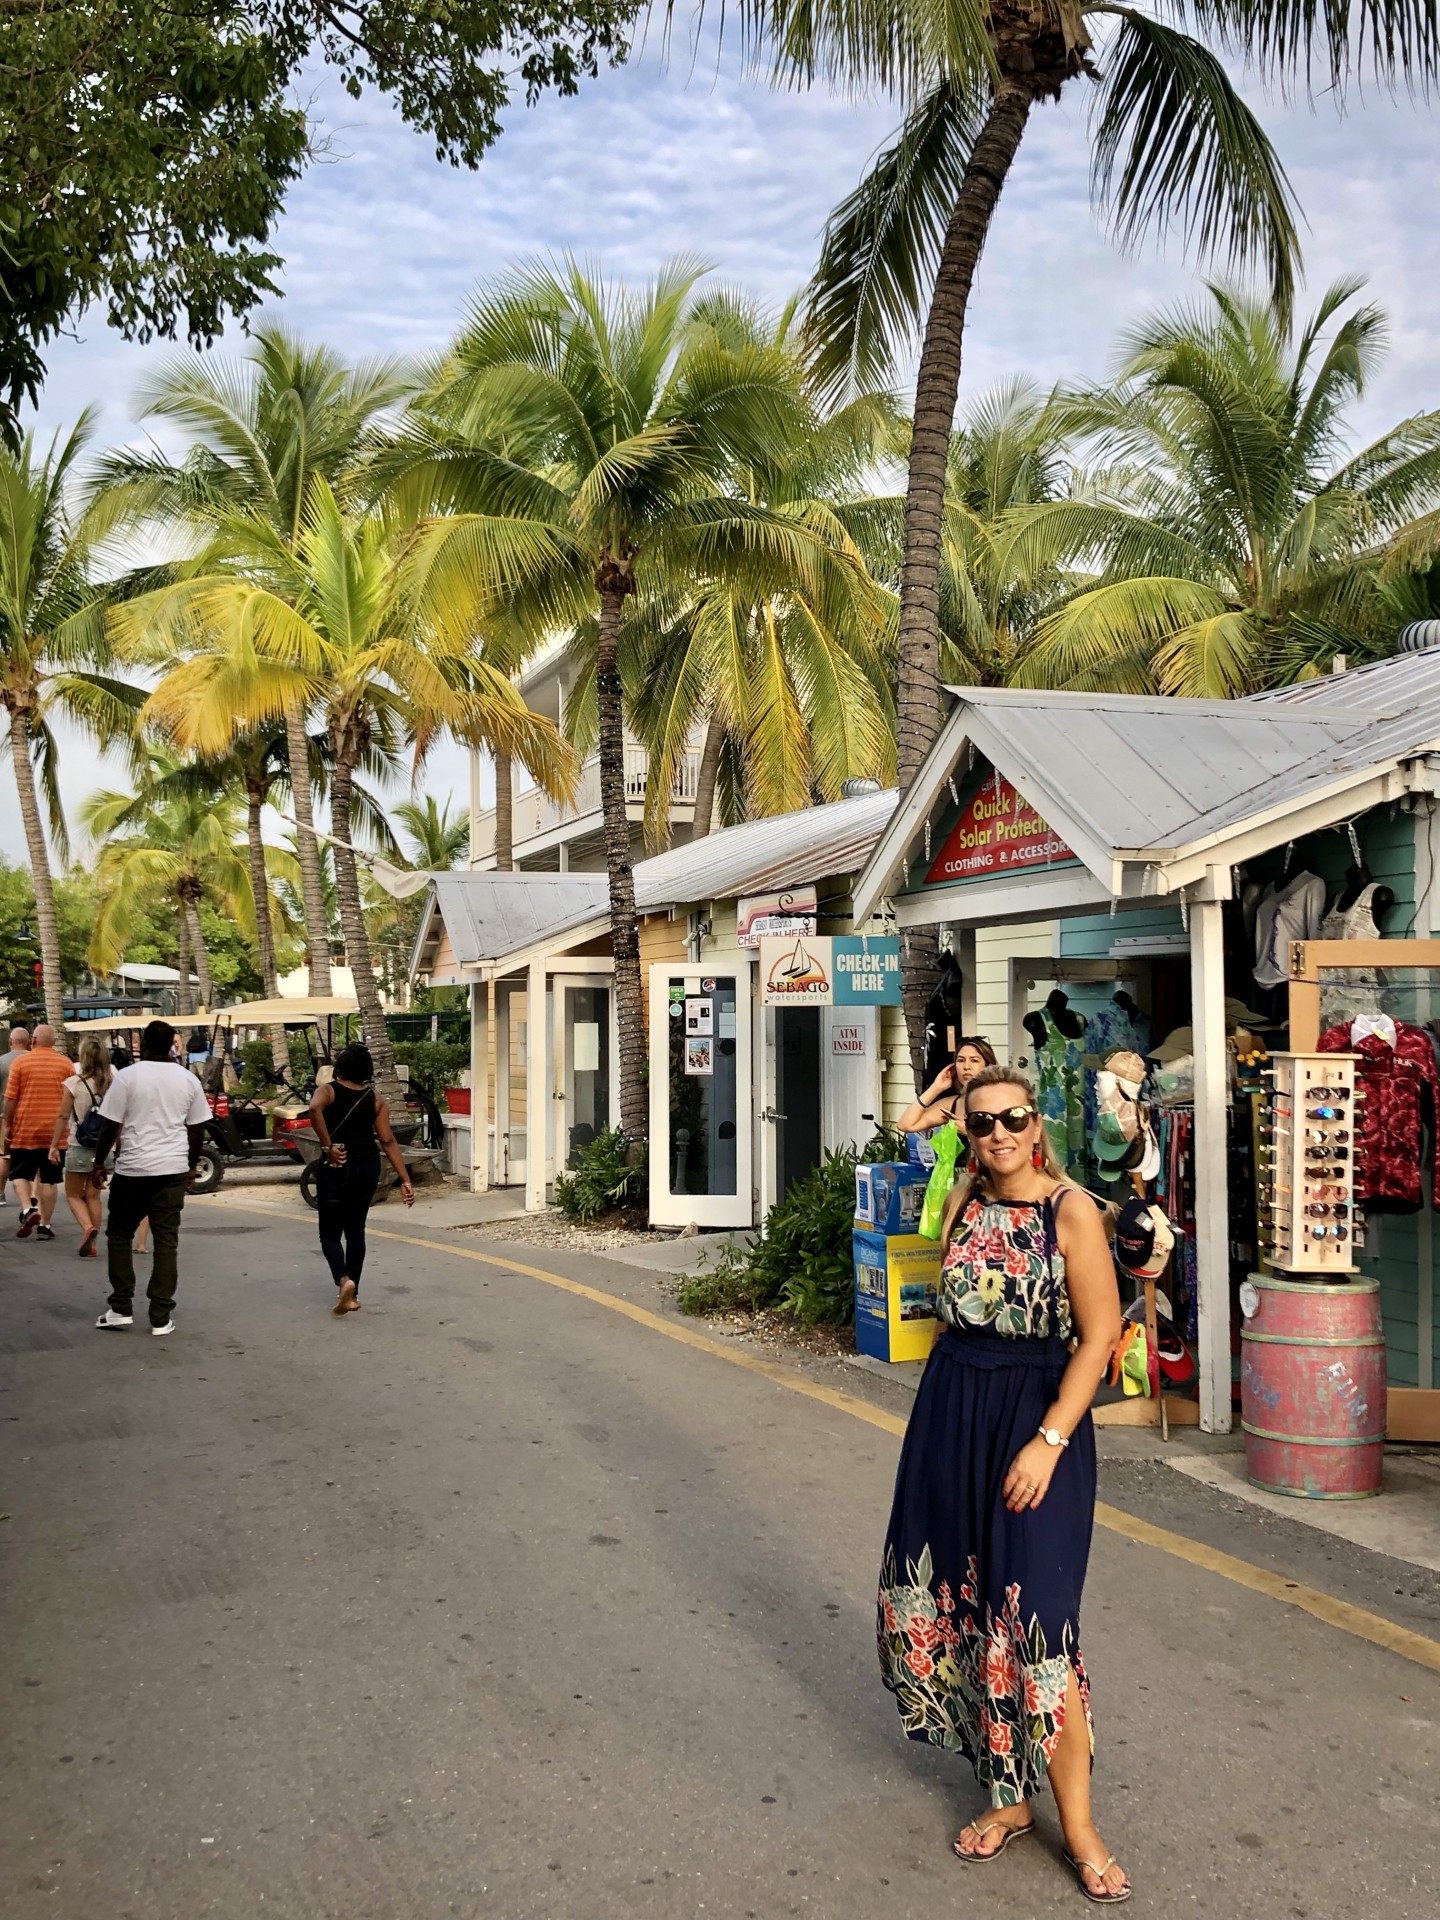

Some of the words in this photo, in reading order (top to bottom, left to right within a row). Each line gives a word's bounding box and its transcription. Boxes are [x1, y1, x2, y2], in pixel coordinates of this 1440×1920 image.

[973, 792, 1011, 821] Quick
[960, 824, 992, 849] Solar
[944, 854, 994, 873] CLOTHING
[999, 851, 1009, 863] &
[1010, 840, 1071, 862] ACCESSOR
[836, 954, 899, 972] CHECK-IN
[766, 981, 830, 993] SEBAGO
[851, 973, 885, 992] HERE
[767, 994, 828, 1003] watersports
[839, 1028, 858, 1039] ATM
[833, 1040, 864, 1051] INSIDE
